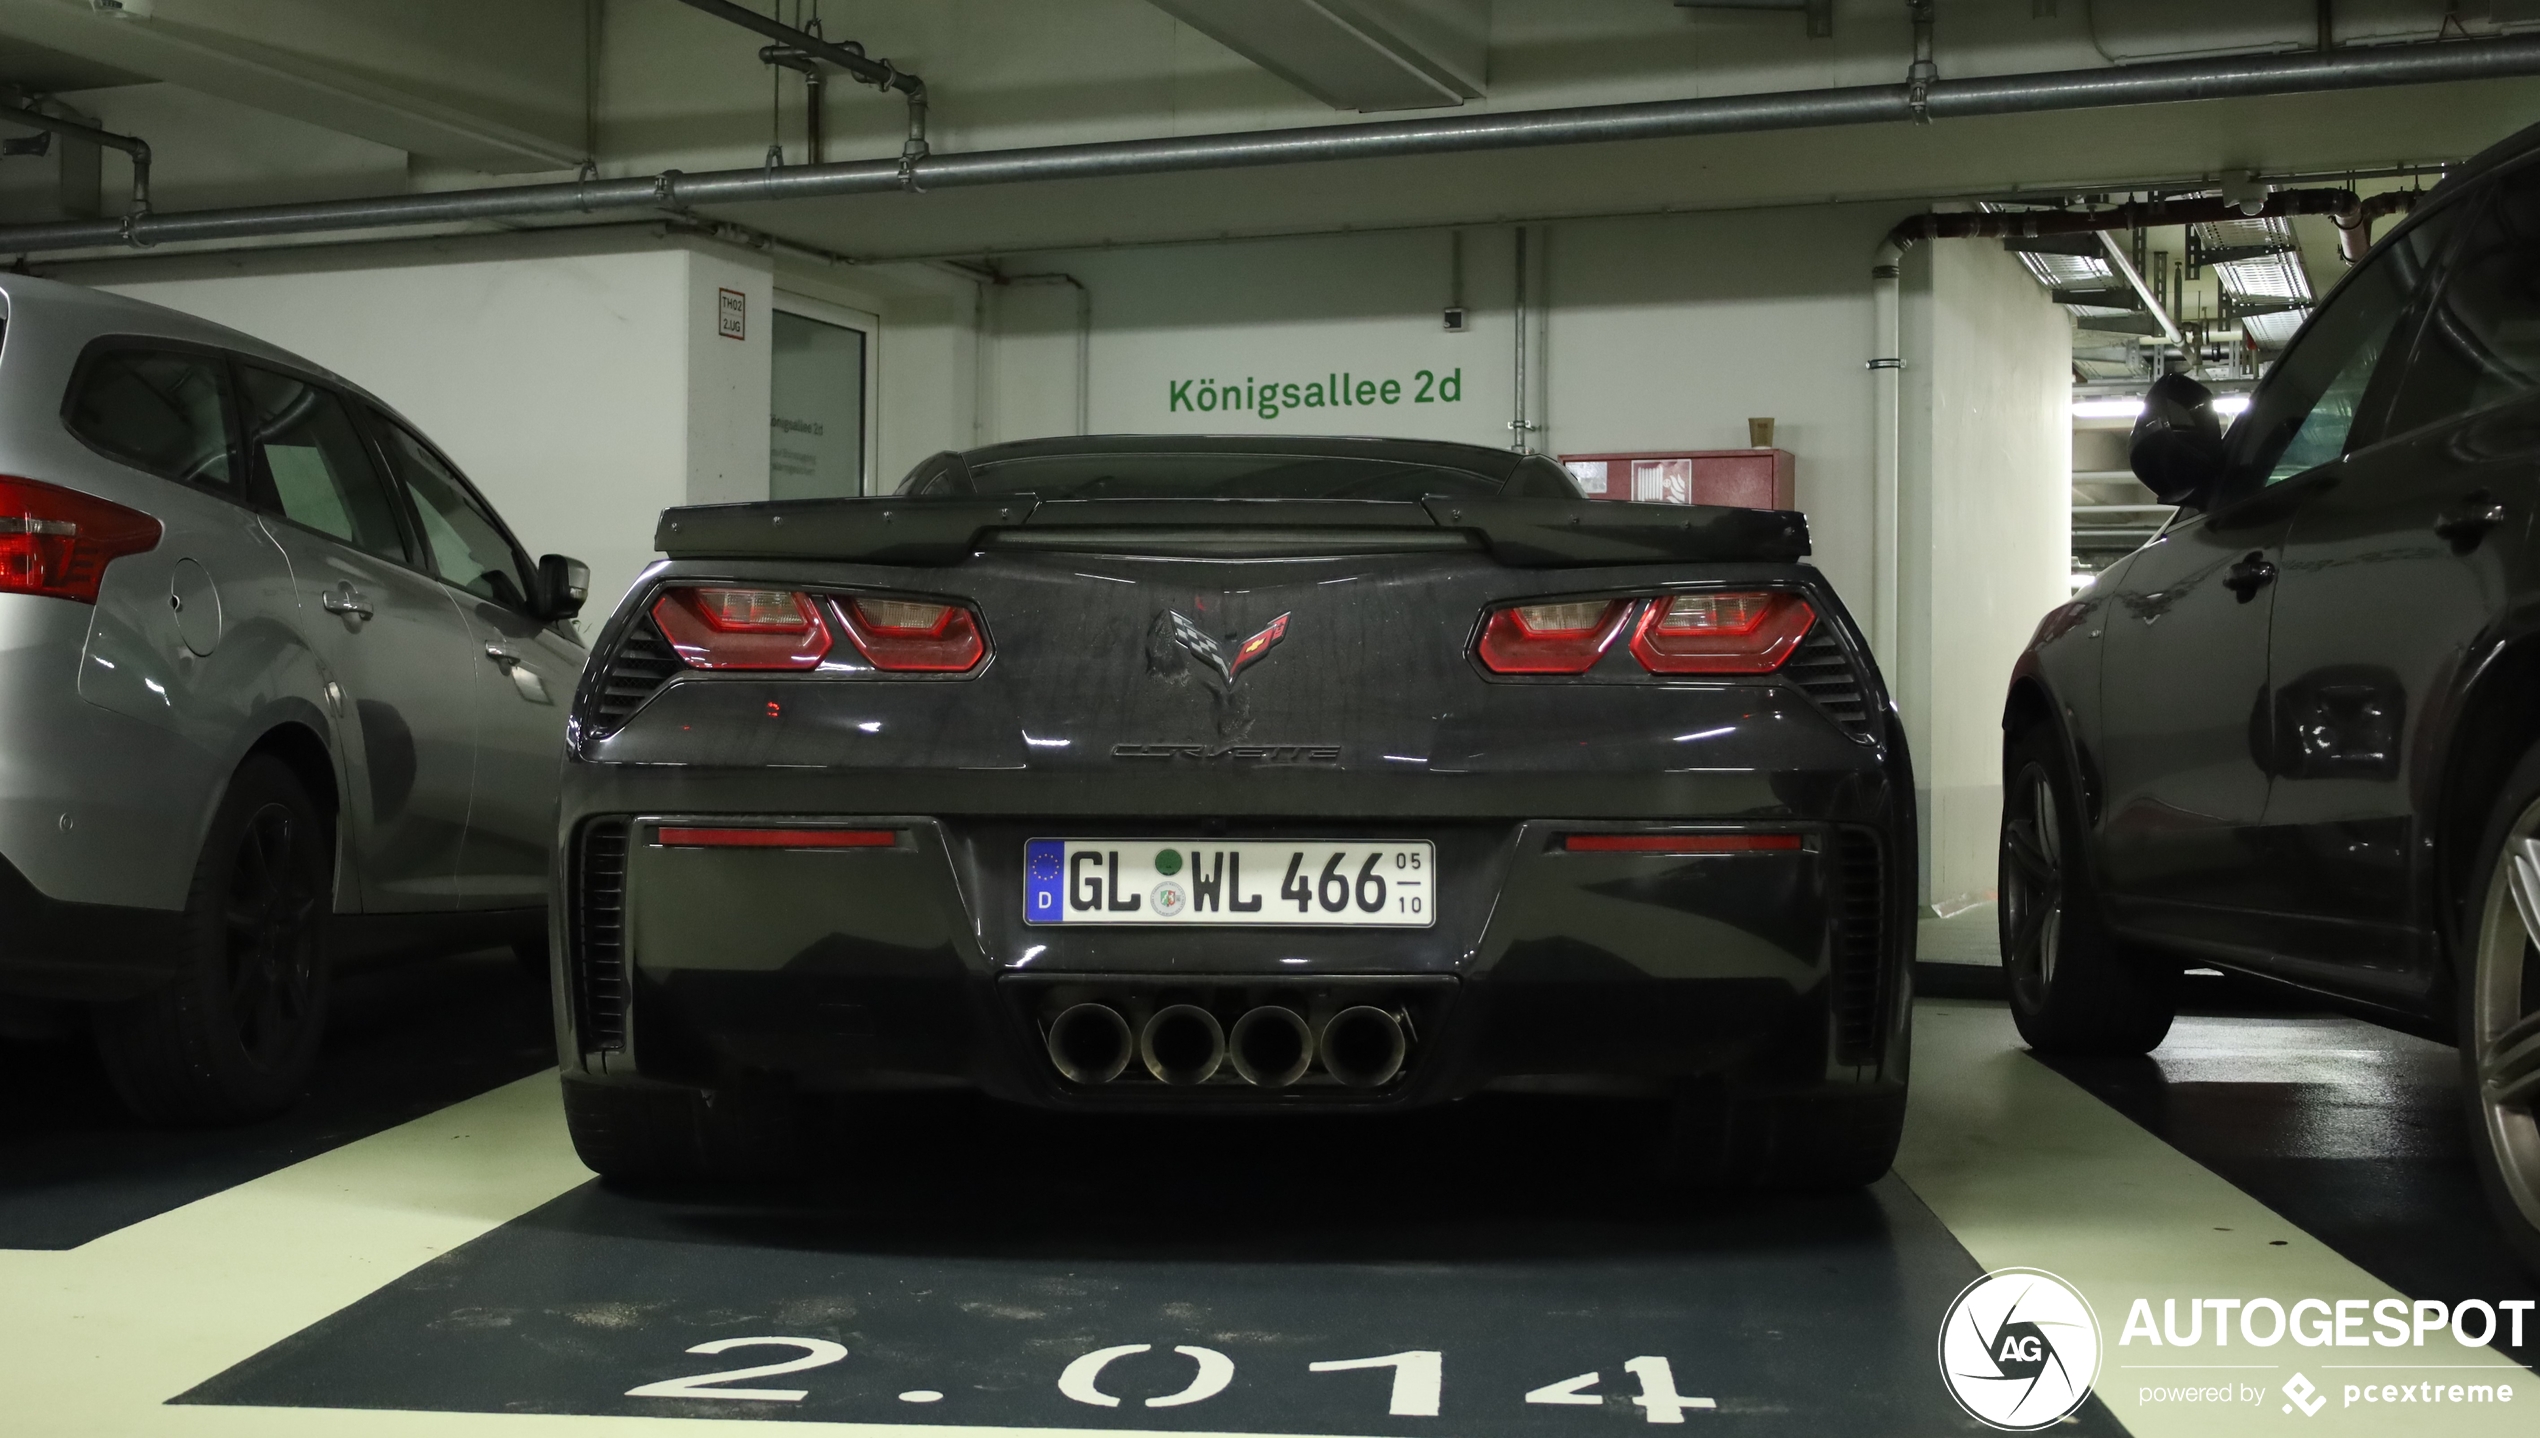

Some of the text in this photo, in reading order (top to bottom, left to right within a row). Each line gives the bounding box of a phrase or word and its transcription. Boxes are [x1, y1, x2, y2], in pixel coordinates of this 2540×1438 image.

[722, 296, 742, 312] TH02
[723, 318, 741, 332] 2.UG
[1169, 368, 1461, 420] Königsallee 2d
[770, 413, 812, 434] önigsallee
[1395, 852, 1423, 870] 05
[1069, 851, 1142, 912] GL
[1190, 851, 1263, 912] WL
[1280, 852, 1388, 913] 466
[1037, 891, 1053, 909] D
[1397, 896, 1423, 914] 10
